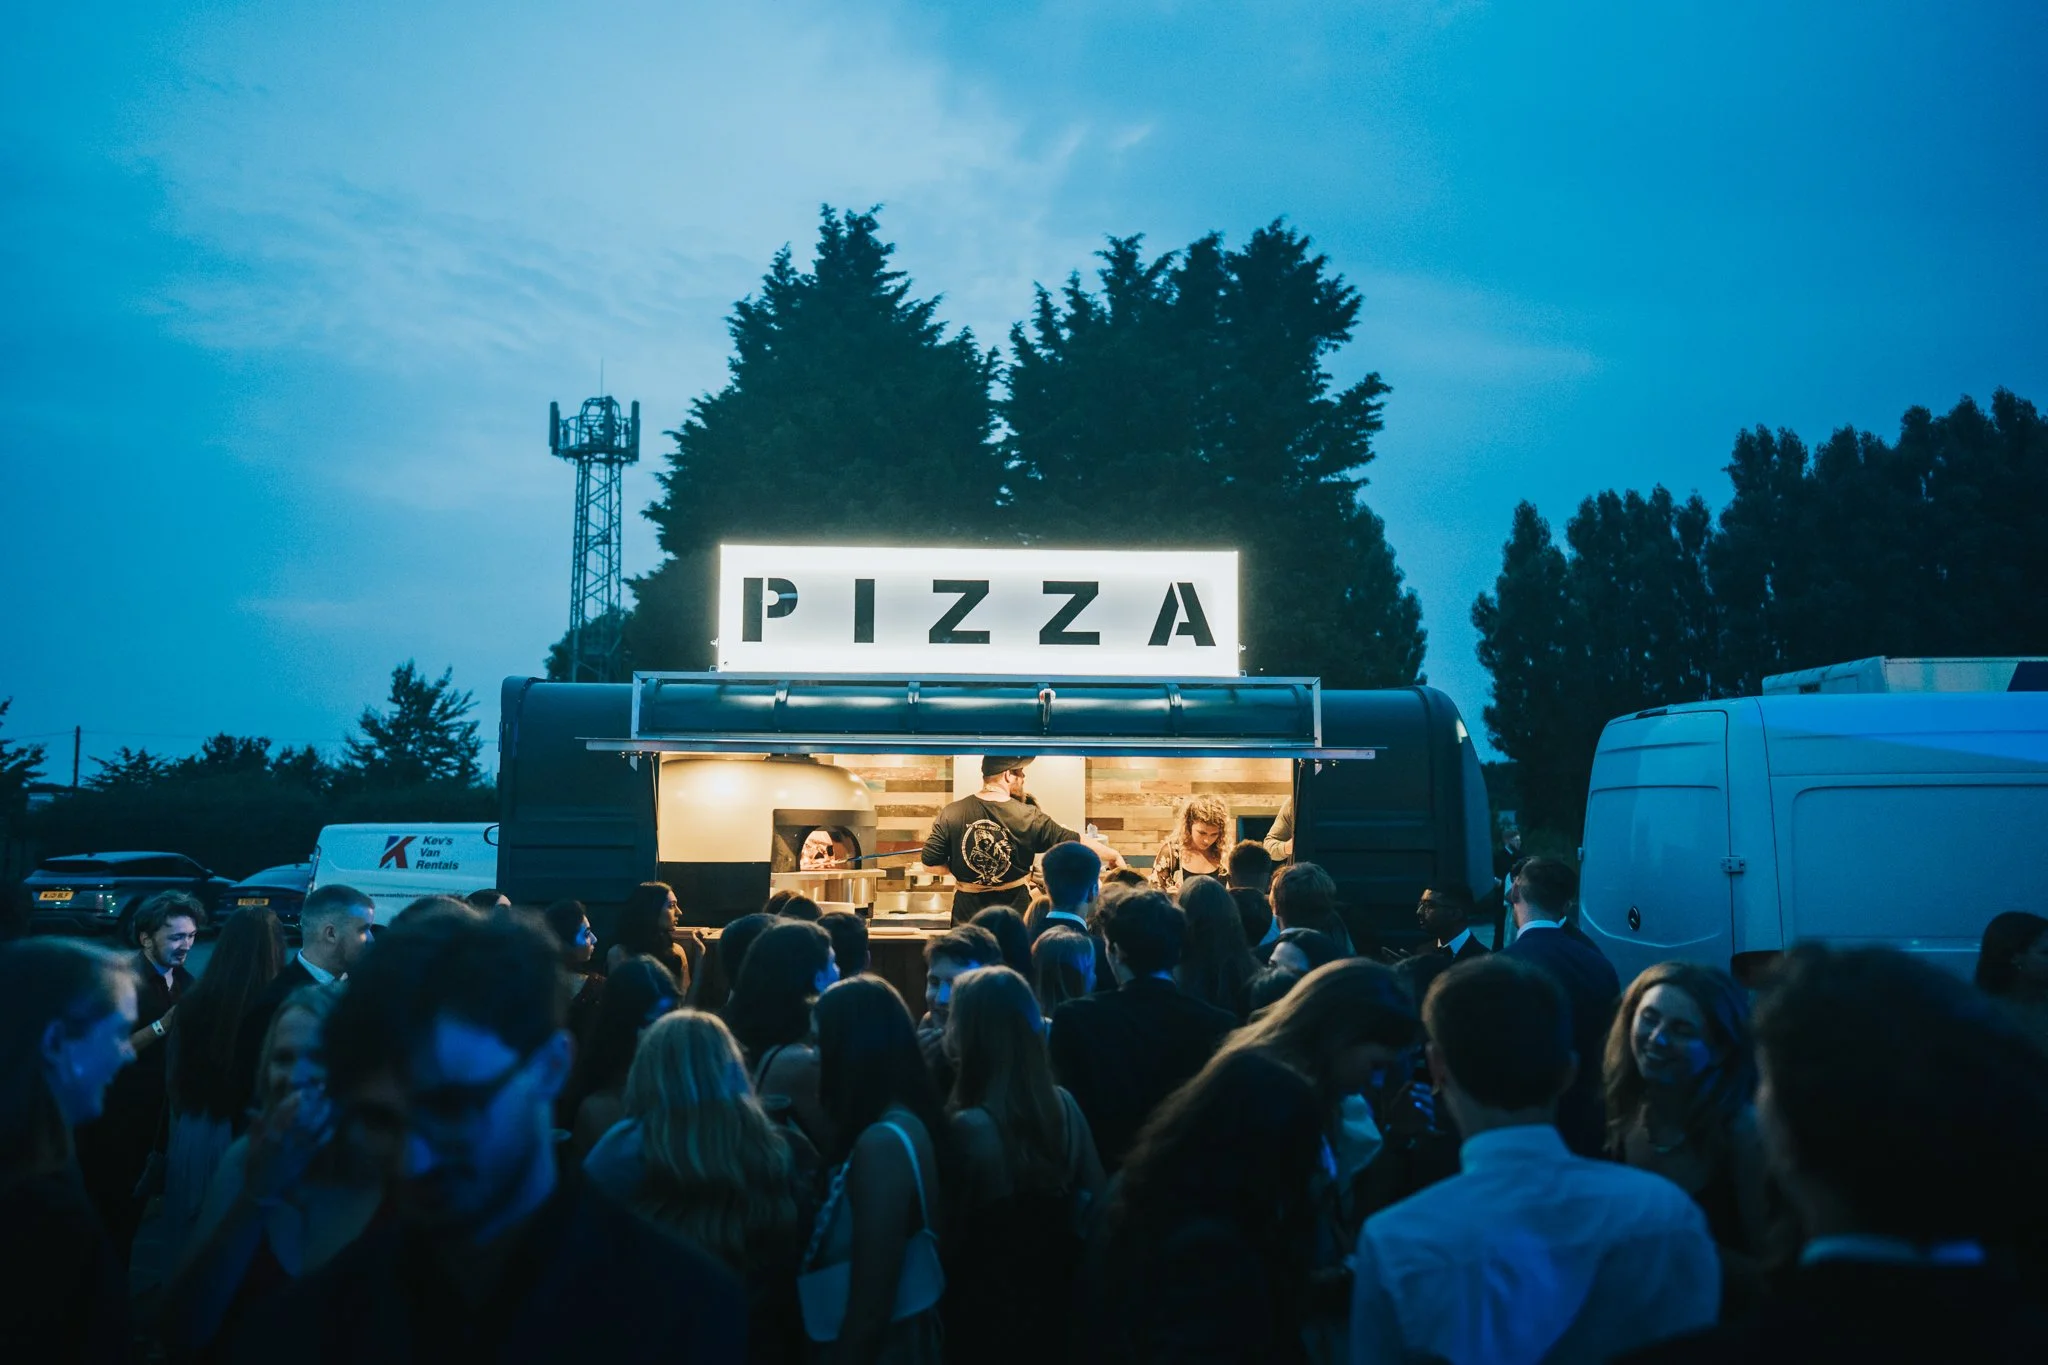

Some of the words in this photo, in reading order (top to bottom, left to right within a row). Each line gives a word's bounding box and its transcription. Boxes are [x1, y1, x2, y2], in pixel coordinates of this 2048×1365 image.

[742, 577, 1217, 647] PIZZA
[422, 835, 454, 846] Kev's
[420, 847, 440, 857] Van
[415, 860, 459, 871] Rentals
